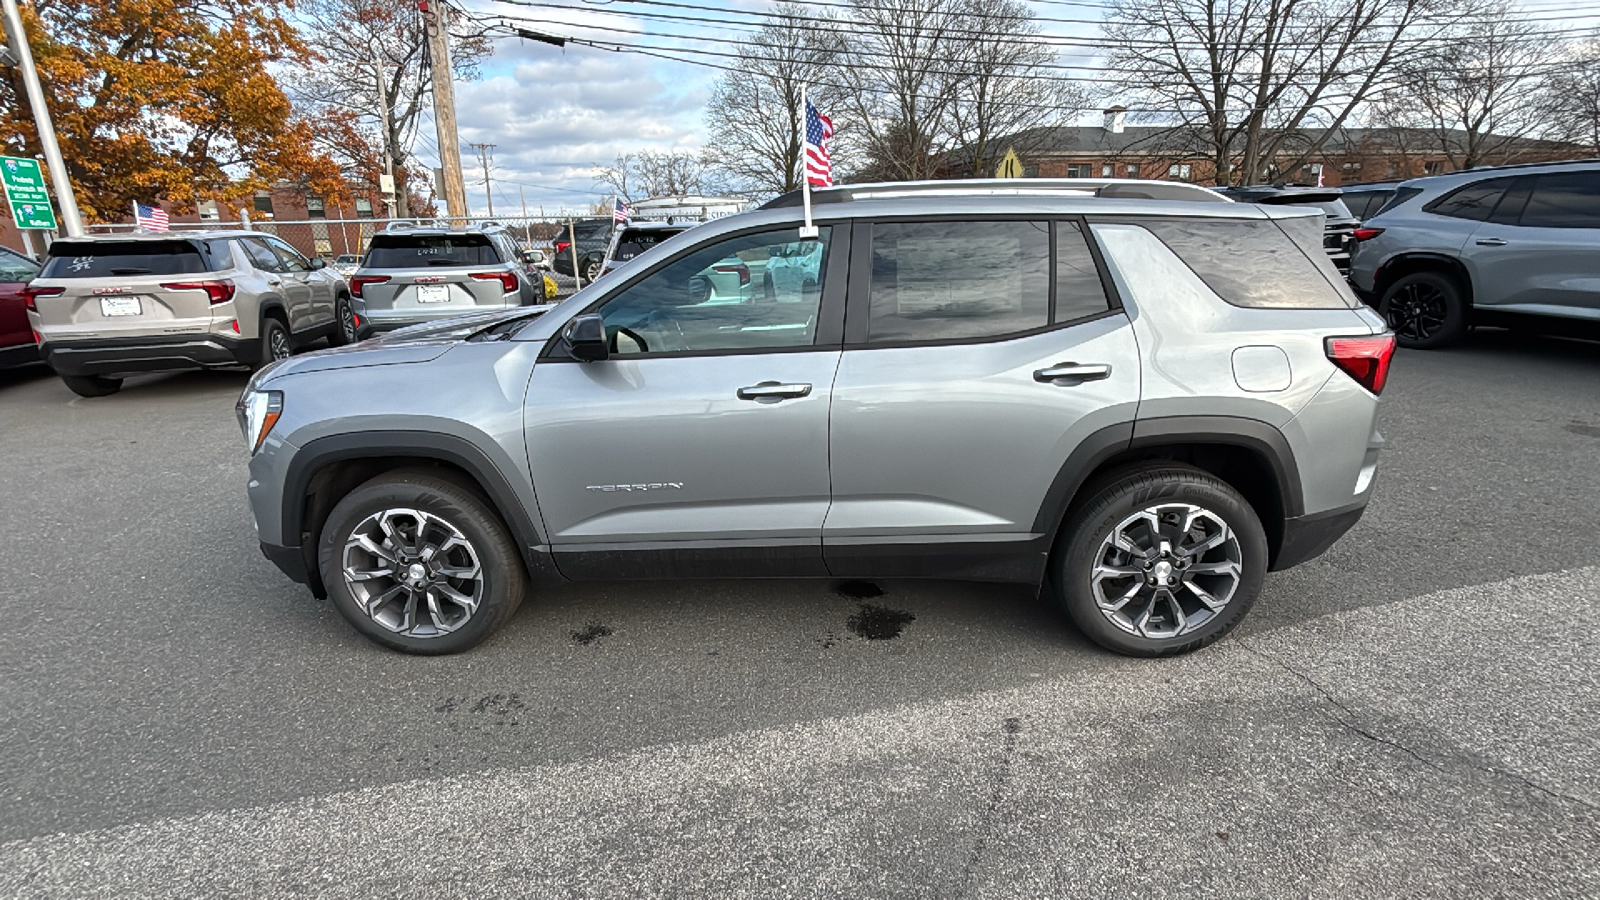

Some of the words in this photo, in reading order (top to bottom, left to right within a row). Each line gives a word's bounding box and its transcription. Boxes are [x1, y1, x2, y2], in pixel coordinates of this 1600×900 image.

[413, 276, 447, 284] GMC
[92, 286, 133, 295] GMC
[586, 481, 684, 492] TERRAIN
